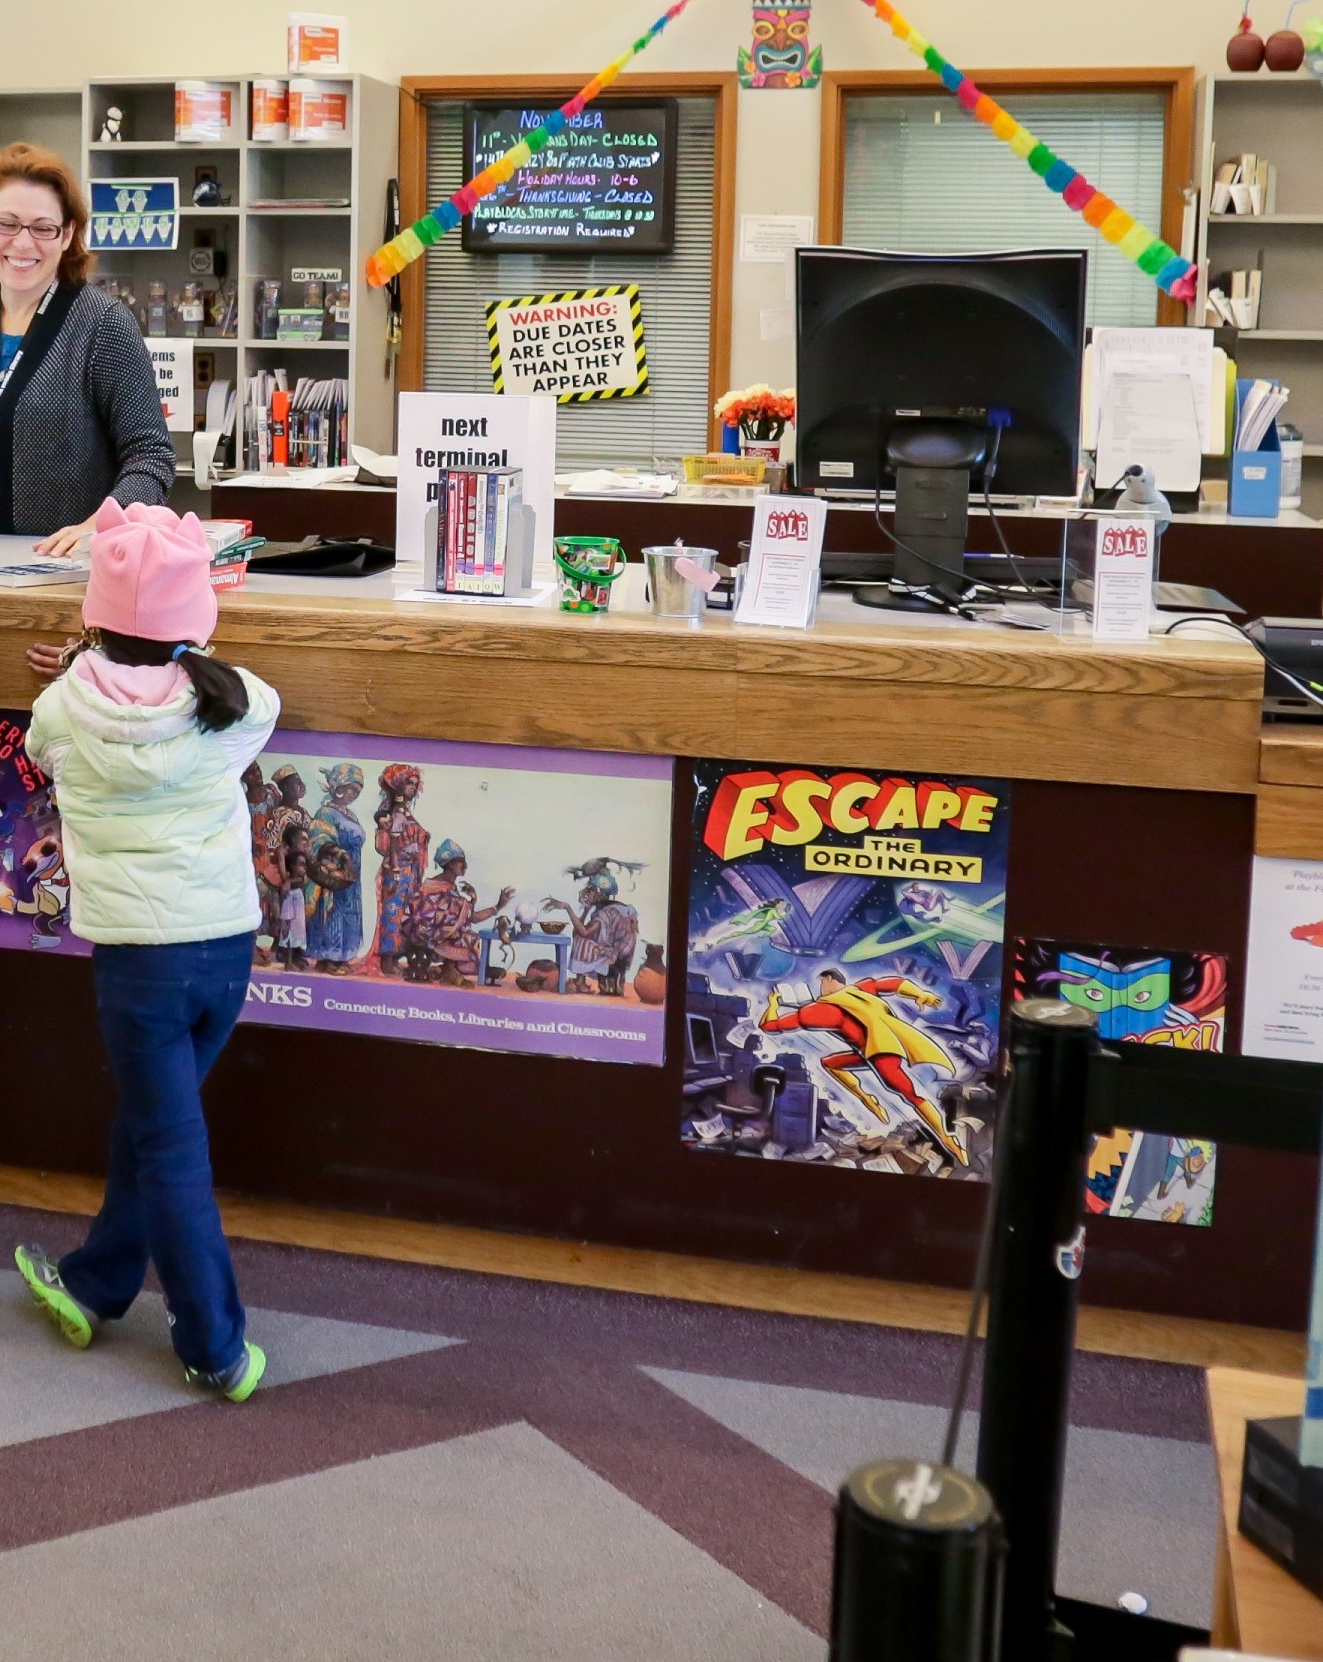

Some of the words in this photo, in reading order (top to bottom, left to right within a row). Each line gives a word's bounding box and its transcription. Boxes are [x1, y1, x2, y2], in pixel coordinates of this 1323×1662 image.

[520, 110, 603, 128] NOVBER
[602, 132, 658, 147] CLOSED
[518, 169, 563, 185] HOLIDAY
[610, 173, 639, 186] 10-6
[517, 185, 592, 204] THANKSGIVING
[604, 188, 653, 204] CLOSED
[499, 221, 570, 236] REGISTRATION
[577, 222, 631, 237] REQUIRED
[293, 272, 306, 280] GO
[509, 302, 618, 326] WARNING:
[513, 326, 551, 344] DUE
[558, 318, 617, 338] DATES
[151, 351, 176, 362] ems
[509, 344, 545, 361] ARE
[552, 335, 626, 356] CLOSER
[159, 367, 173, 380] be
[512, 358, 568, 377] THAN
[575, 352, 624, 370] THEY
[158, 385, 179, 398] ged
[532, 372, 609, 393] APPEAR
[441, 417, 488, 437] next
[415, 447, 508, 468] terminal
[767, 516, 808, 540] SALE
[1103, 530, 1147, 556] SALE
[210, 572, 239, 585] Almana
[703, 769, 999, 861] ESCAPE
[870, 839, 916, 853] THE
[812, 850, 976, 876] ORDINARY
[244, 982, 313, 1008] NKS
[323, 998, 406, 1019] Connecting
[408, 1006, 456, 1024] Books,
[458, 1011, 524, 1031] Libraries
[526, 1021, 555, 1034] and
[557, 1022, 647, 1042] Classrooms
